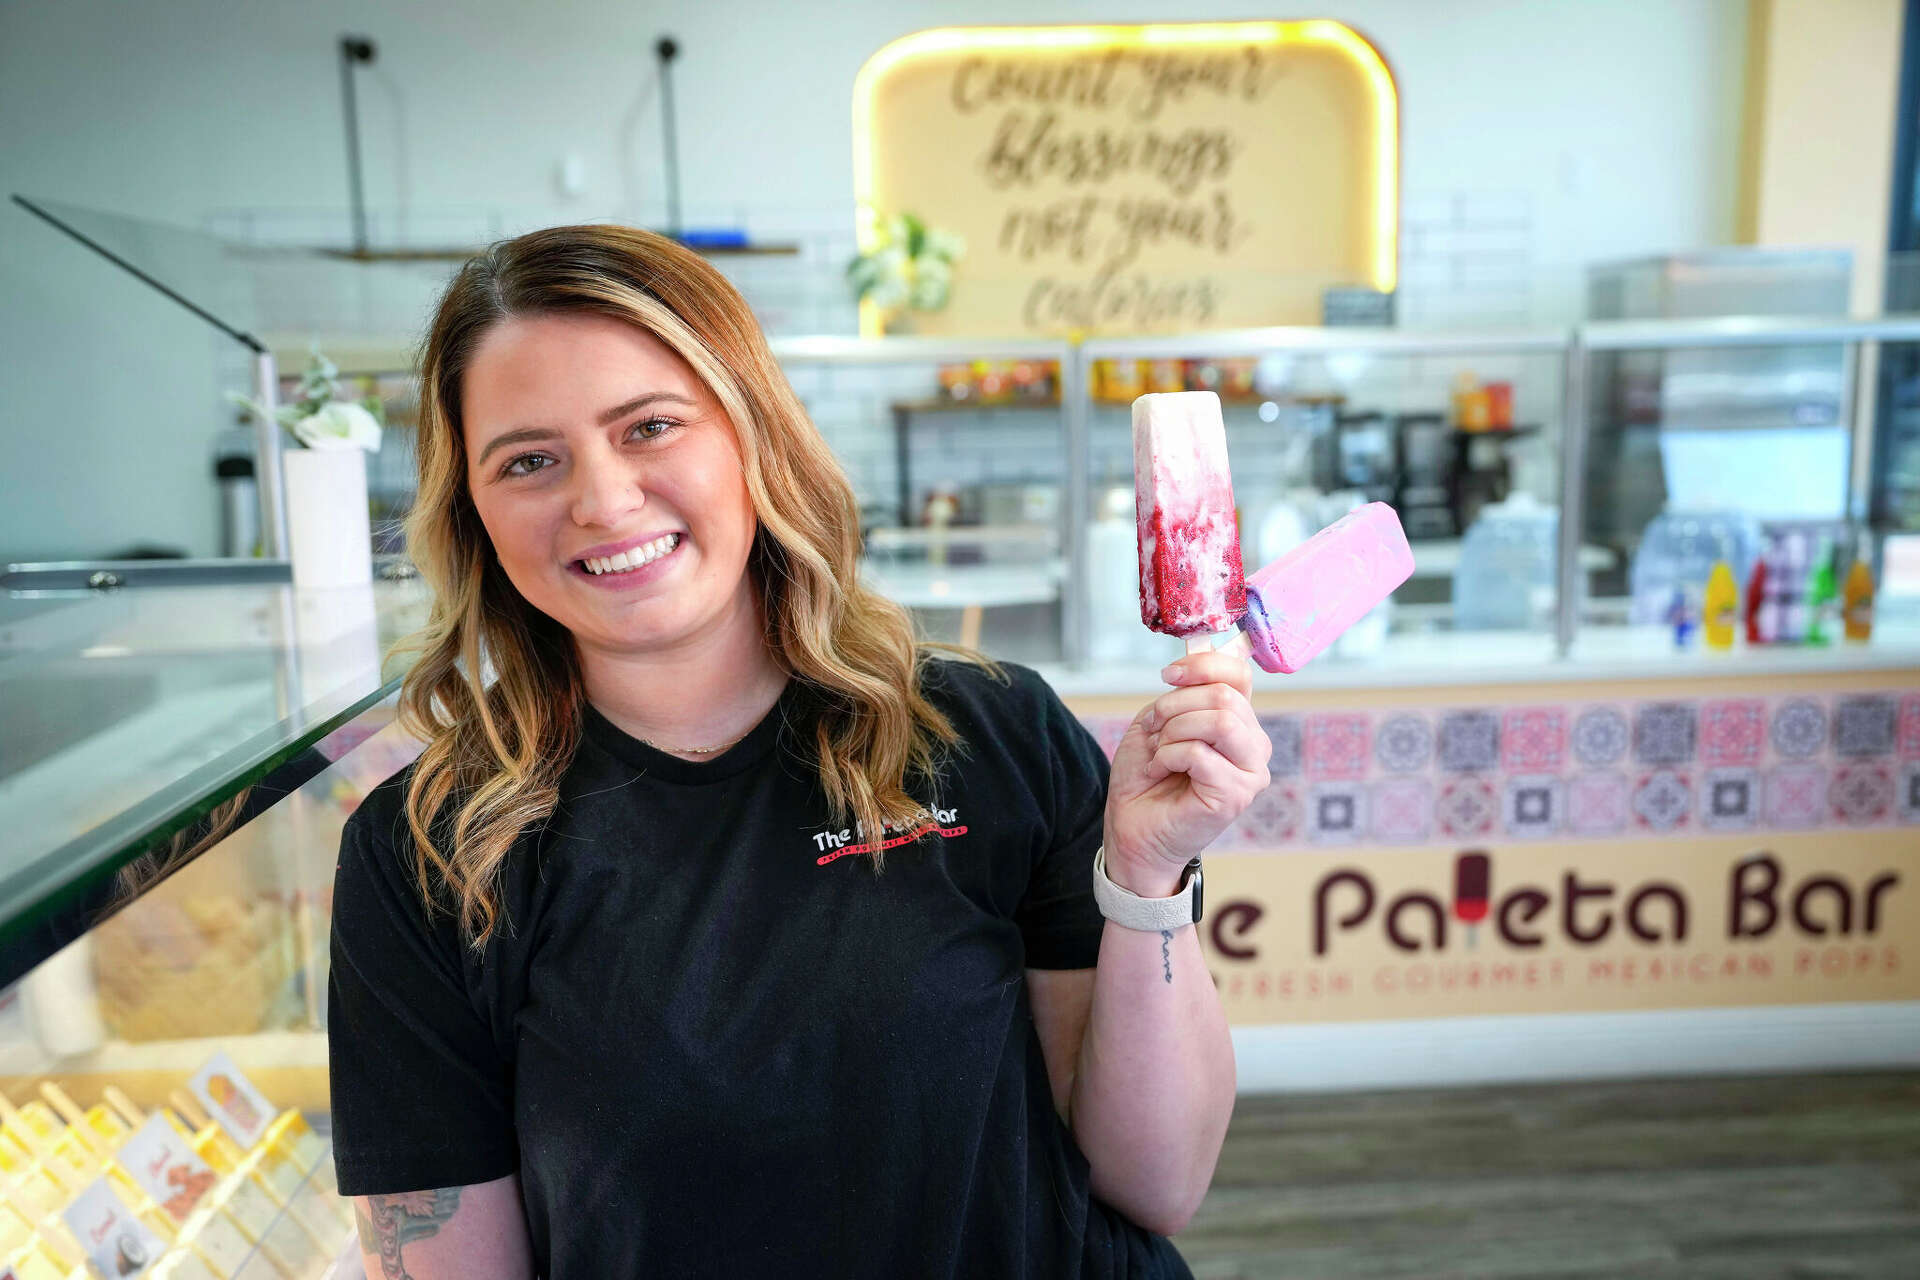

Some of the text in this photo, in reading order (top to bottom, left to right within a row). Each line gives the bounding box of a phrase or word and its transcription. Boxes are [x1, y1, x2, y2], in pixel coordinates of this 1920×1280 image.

[1130, 46, 1270, 122] your
[999, 190, 1242, 290] not your
[813, 828, 851, 851] The
[1312, 851, 1690, 958] Paleta
[1729, 852, 1899, 941] Bar
[1373, 957, 1564, 996] GOURMET
[1588, 952, 1774, 987] MEXICAN
[1794, 946, 1900, 979] POPS
